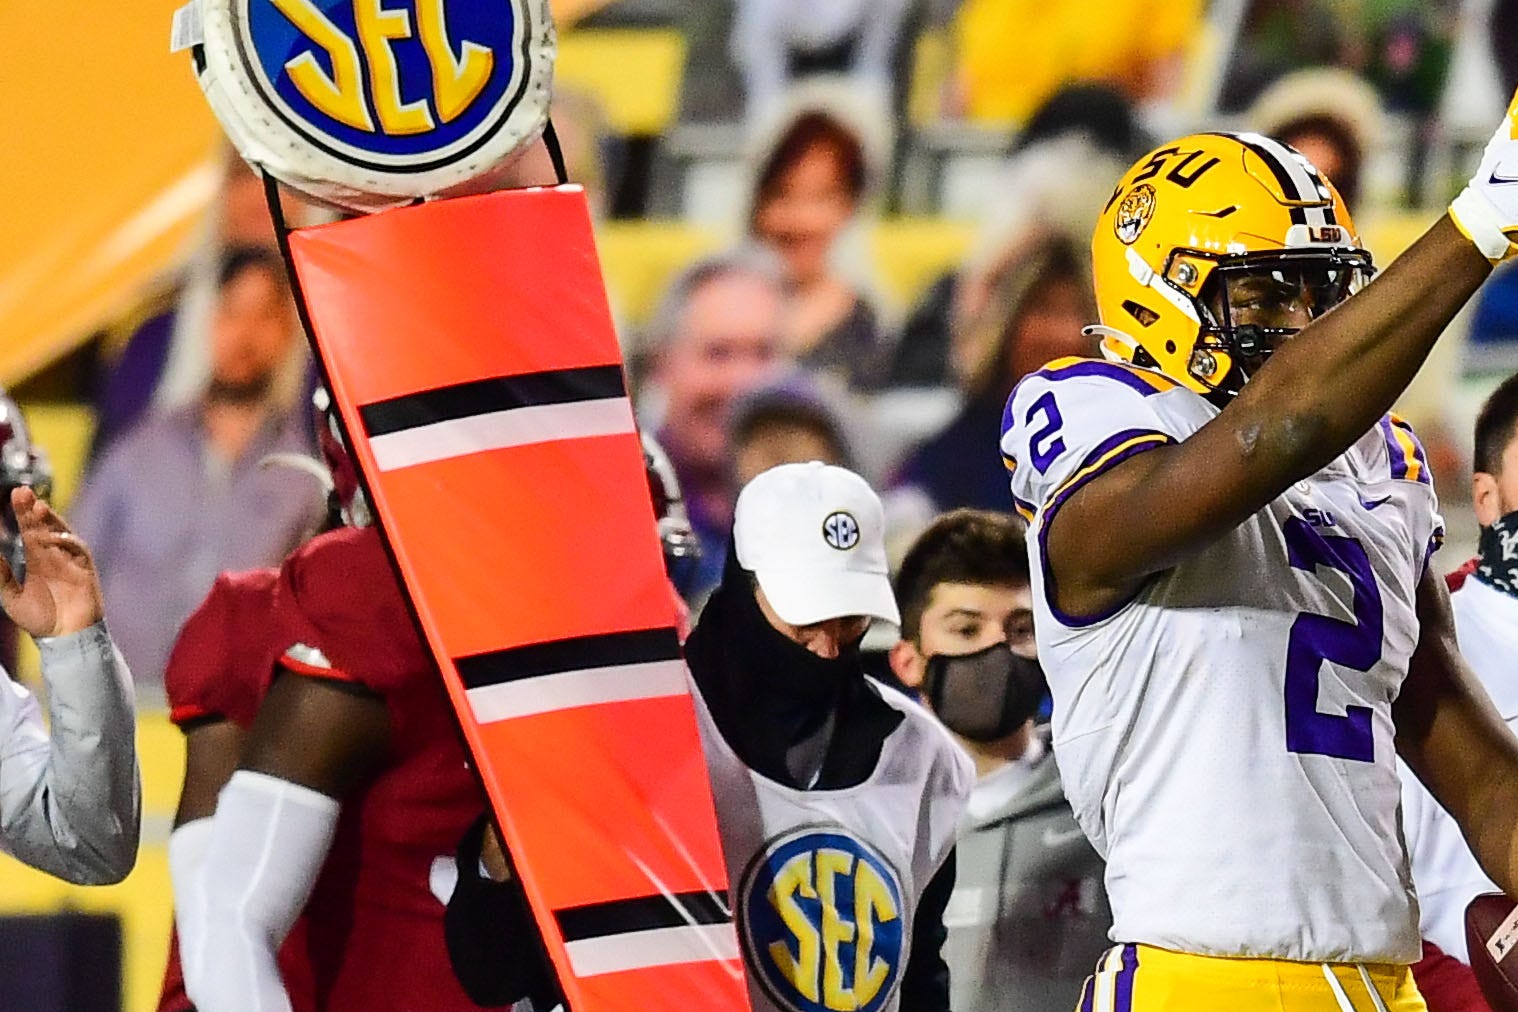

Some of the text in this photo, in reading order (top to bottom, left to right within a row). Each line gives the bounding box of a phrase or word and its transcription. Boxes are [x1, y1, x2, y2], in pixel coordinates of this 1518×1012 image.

[271, 0, 494, 135] SEC
[1308, 225, 1342, 243] LSU
[1025, 391, 1067, 477] 2
[1284, 514, 1375, 763] 2
[768, 848, 898, 1012] SEC
